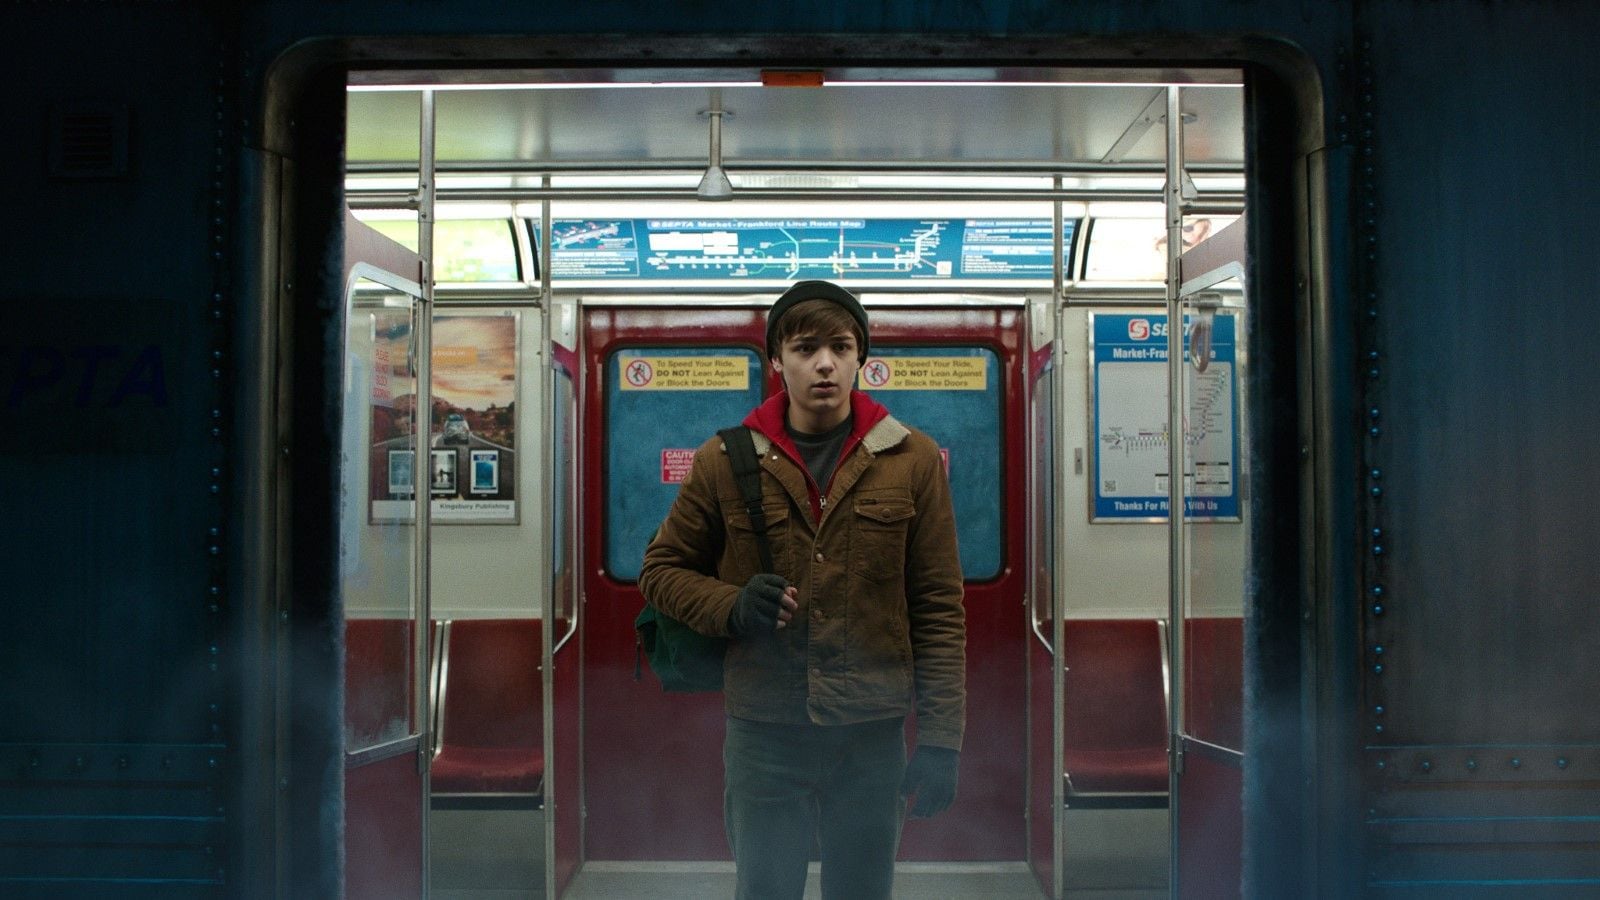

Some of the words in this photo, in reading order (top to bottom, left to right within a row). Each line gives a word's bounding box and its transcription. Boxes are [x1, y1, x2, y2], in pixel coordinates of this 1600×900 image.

[786, 220, 807, 228] Line
[809, 220, 838, 228] Route
[840, 220, 862, 228] Map
[668, 359, 693, 369] Speed
[906, 359, 931, 369] Speed
[656, 369, 670, 377] DO
[672, 369, 690, 377] NOT
[693, 369, 713, 377] Lean
[714, 369, 745, 379] Against
[894, 369, 908, 377] DO
[910, 369, 928, 377] NOT
[931, 369, 951, 377] Lean
[952, 369, 983, 379] Against
[706, 378, 730, 386] Doors
[944, 378, 968, 386] Doors
[665, 451, 694, 459] CAUTI
[439, 503, 473, 511] Kingsbury
[475, 503, 510, 511] Publishing
[1114, 500, 1143, 511] Thanks
[1145, 500, 1158, 511] For
[1207, 500, 1219, 511] Us
